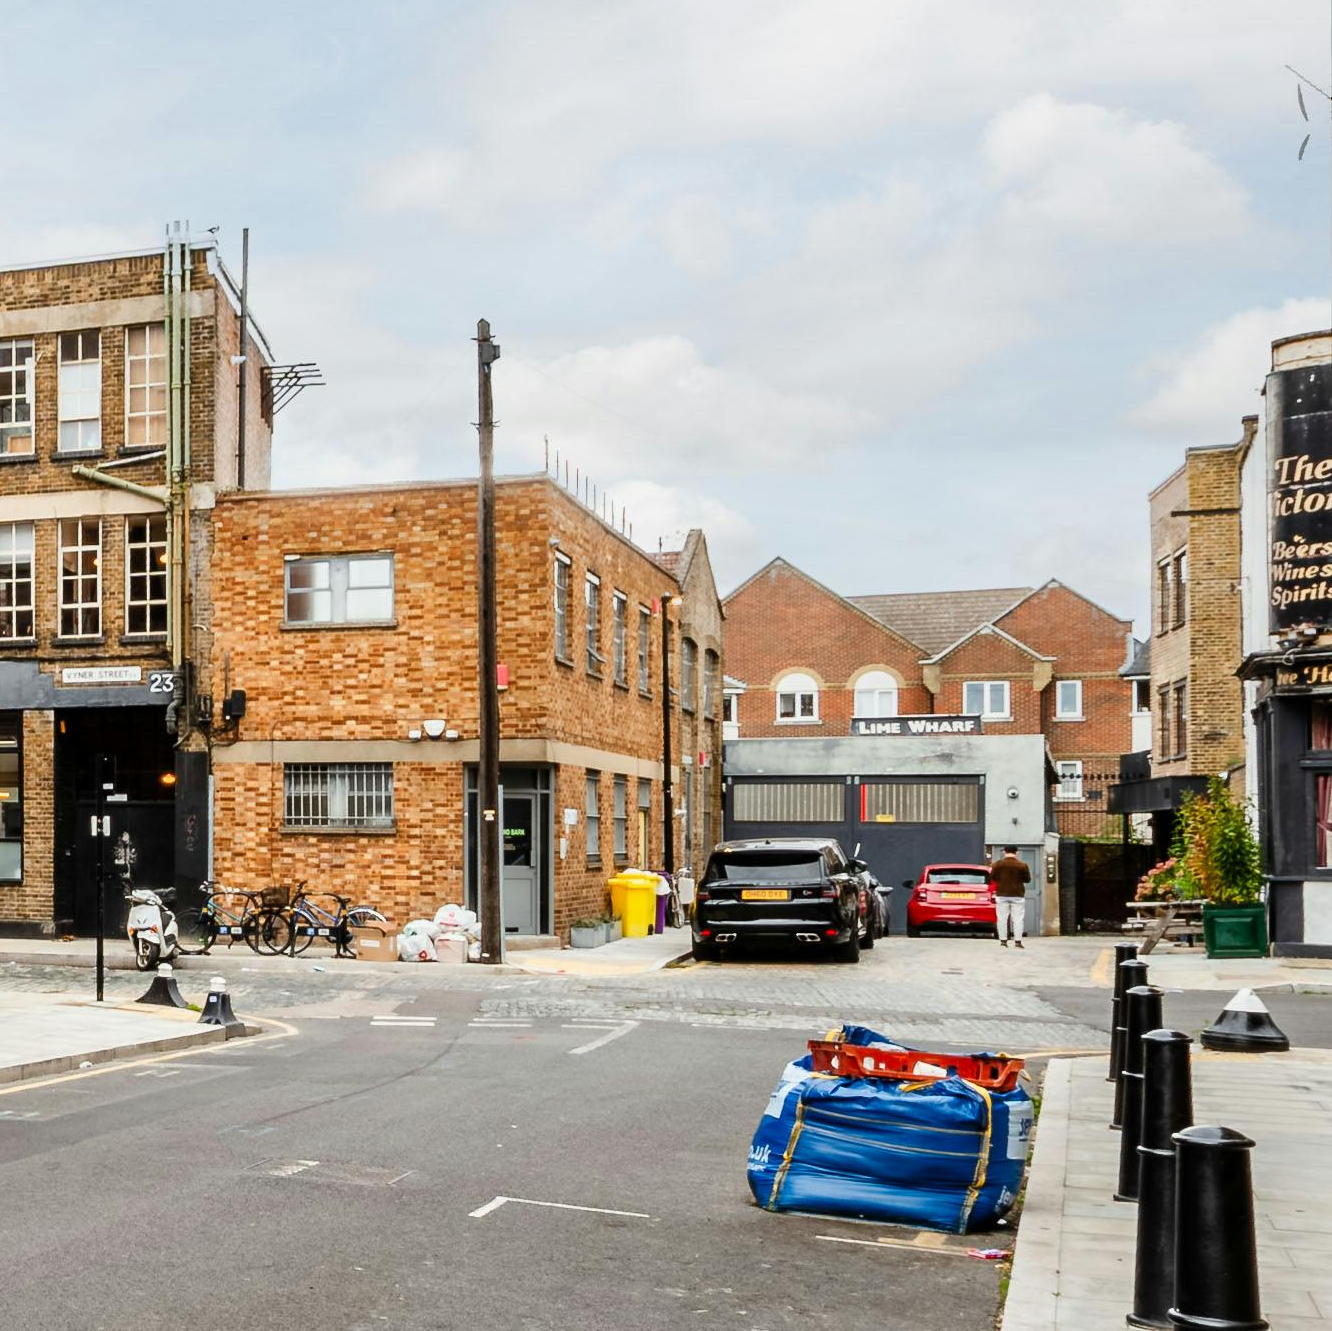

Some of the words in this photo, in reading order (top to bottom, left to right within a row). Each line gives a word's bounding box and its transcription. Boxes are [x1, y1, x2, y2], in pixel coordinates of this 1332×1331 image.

[1274, 454, 1332, 485] The
[1272, 541, 1332, 560] Beers
[1272, 563, 1332, 582] Wines
[66, 670, 94, 679] VYNER
[98, 669, 129, 679] STREET
[149, 673, 175, 693] 23
[858, 721, 901, 735] LIME
[907, 719, 975, 734] WHARF
